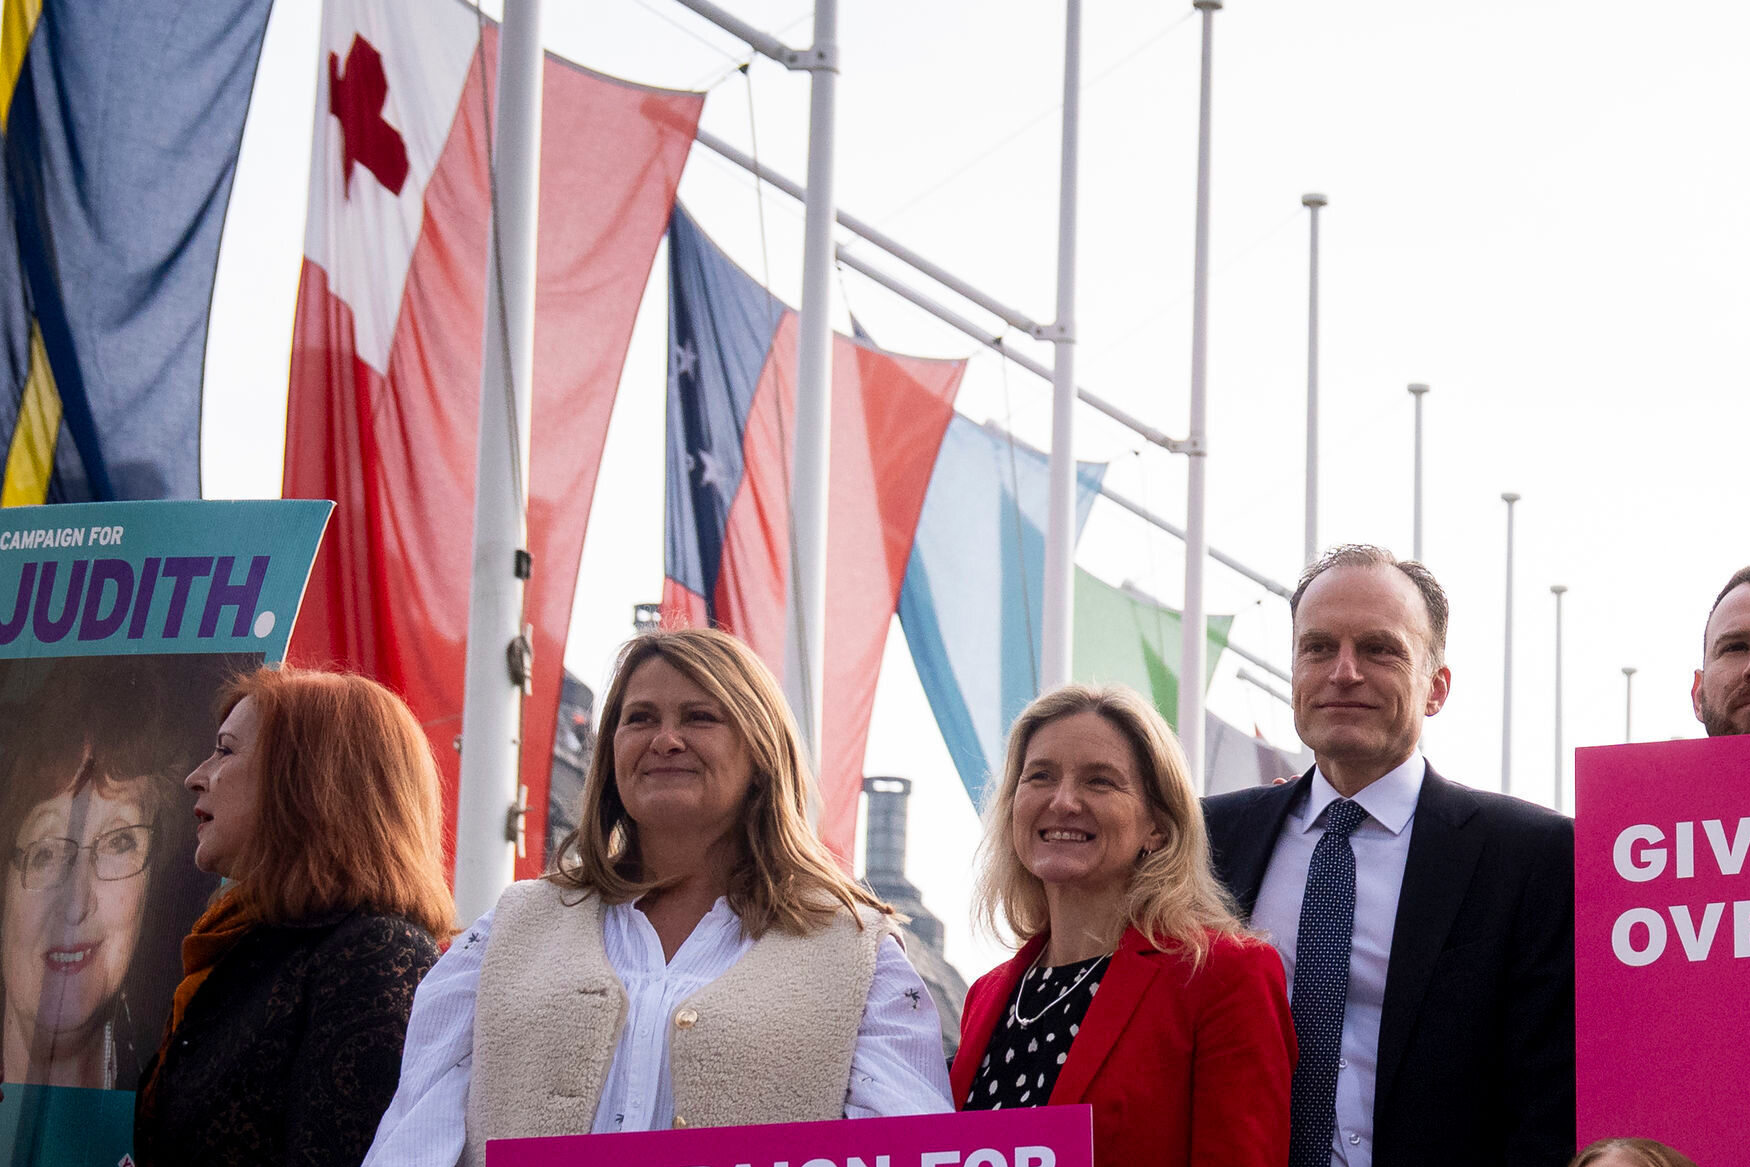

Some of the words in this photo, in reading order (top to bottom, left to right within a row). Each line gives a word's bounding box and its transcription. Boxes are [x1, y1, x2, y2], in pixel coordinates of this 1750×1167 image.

[0, 528, 84, 550] CAMPAIGN
[89, 526, 124, 546] FOR
[0, 555, 276, 645] JUDITH.
